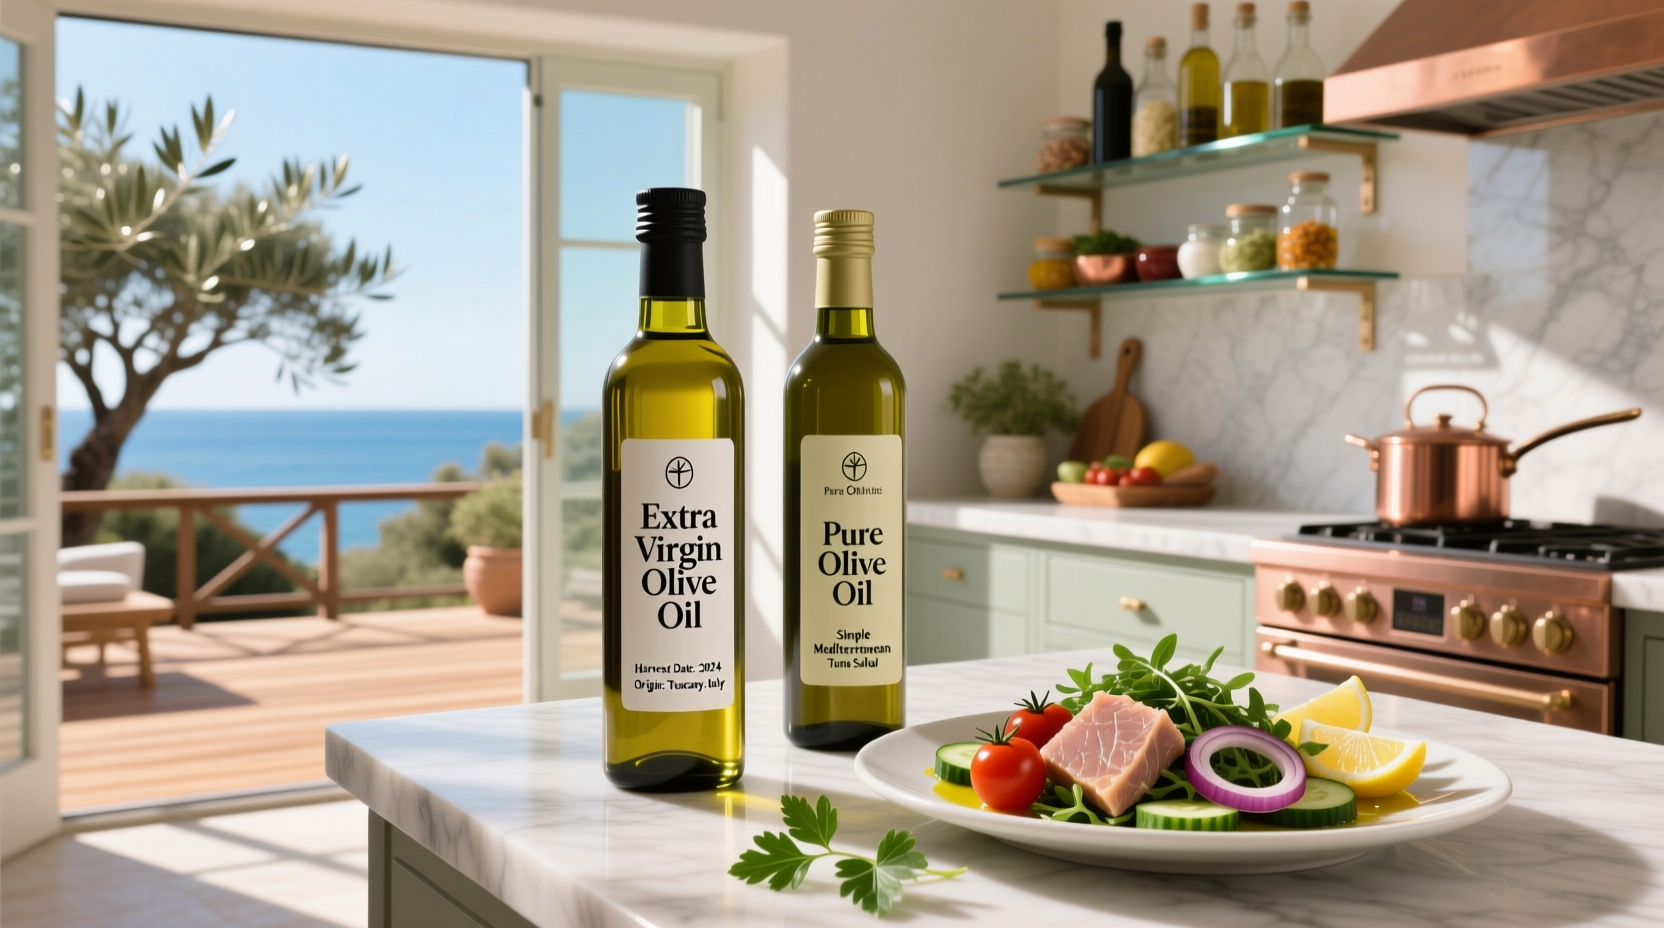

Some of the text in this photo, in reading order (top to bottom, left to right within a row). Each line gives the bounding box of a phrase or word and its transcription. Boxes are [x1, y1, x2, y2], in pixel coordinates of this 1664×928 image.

[640, 502, 718, 530] Extra
[823, 521, 884, 546] Pure
[634, 535, 723, 570] Virgin
[818, 550, 886, 576] Olive
[642, 567, 716, 596] Olive
[832, 579, 873, 606] Oil
[658, 600, 702, 629] Oil
